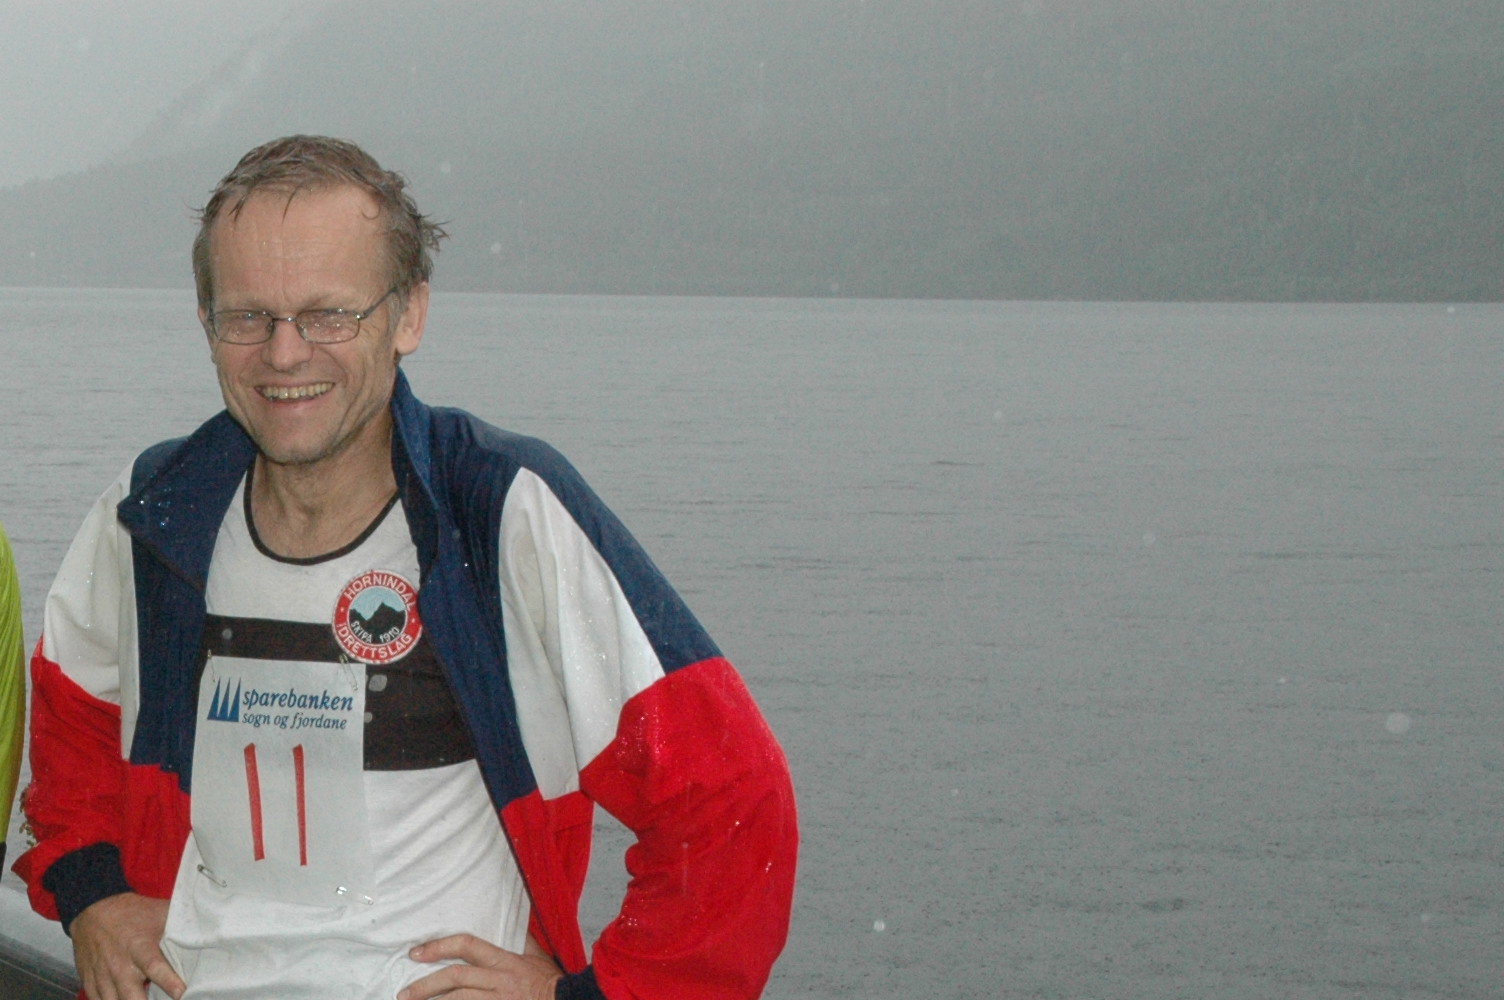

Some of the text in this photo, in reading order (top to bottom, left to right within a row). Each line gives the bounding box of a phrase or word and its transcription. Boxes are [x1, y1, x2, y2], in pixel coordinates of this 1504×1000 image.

[343, 574, 416, 611] HORNINDAL
[336, 622, 413, 658] IDRETTSLAG
[379, 626, 400, 643] 1910
[243, 688, 353, 711] sparebanken
[242, 712, 347, 730] sogn og fjordane
[243, 742, 307, 866] 11
